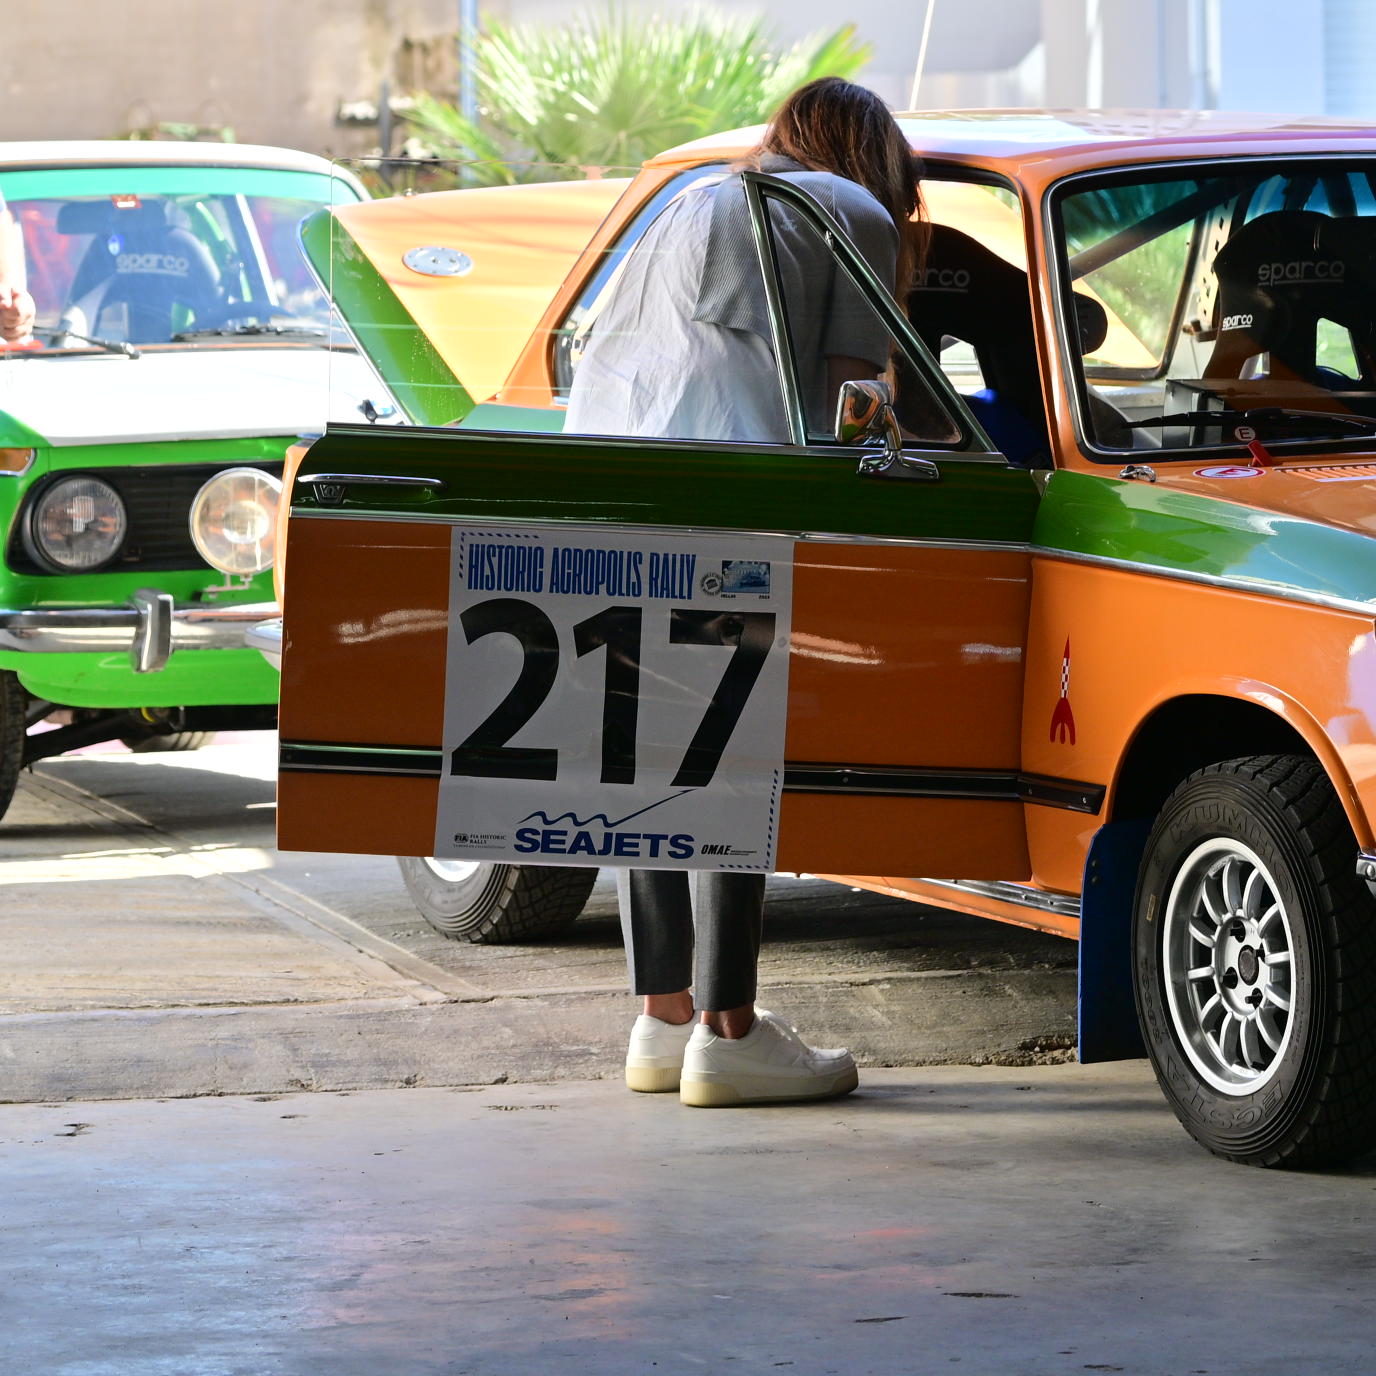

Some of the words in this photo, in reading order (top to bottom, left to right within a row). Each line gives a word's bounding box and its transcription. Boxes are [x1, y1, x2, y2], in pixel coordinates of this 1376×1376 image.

[1258, 261, 1344, 286] sparco
[1223, 314, 1253, 329] sparco
[468, 543, 544, 593] HISTORIC
[549, 547, 643, 597] ACROPOLIS
[649, 552, 697, 600] RALLY
[450, 598, 776, 788] 217
[514, 828, 695, 860] SEAJETS
[701, 844, 732, 855] OMAE
